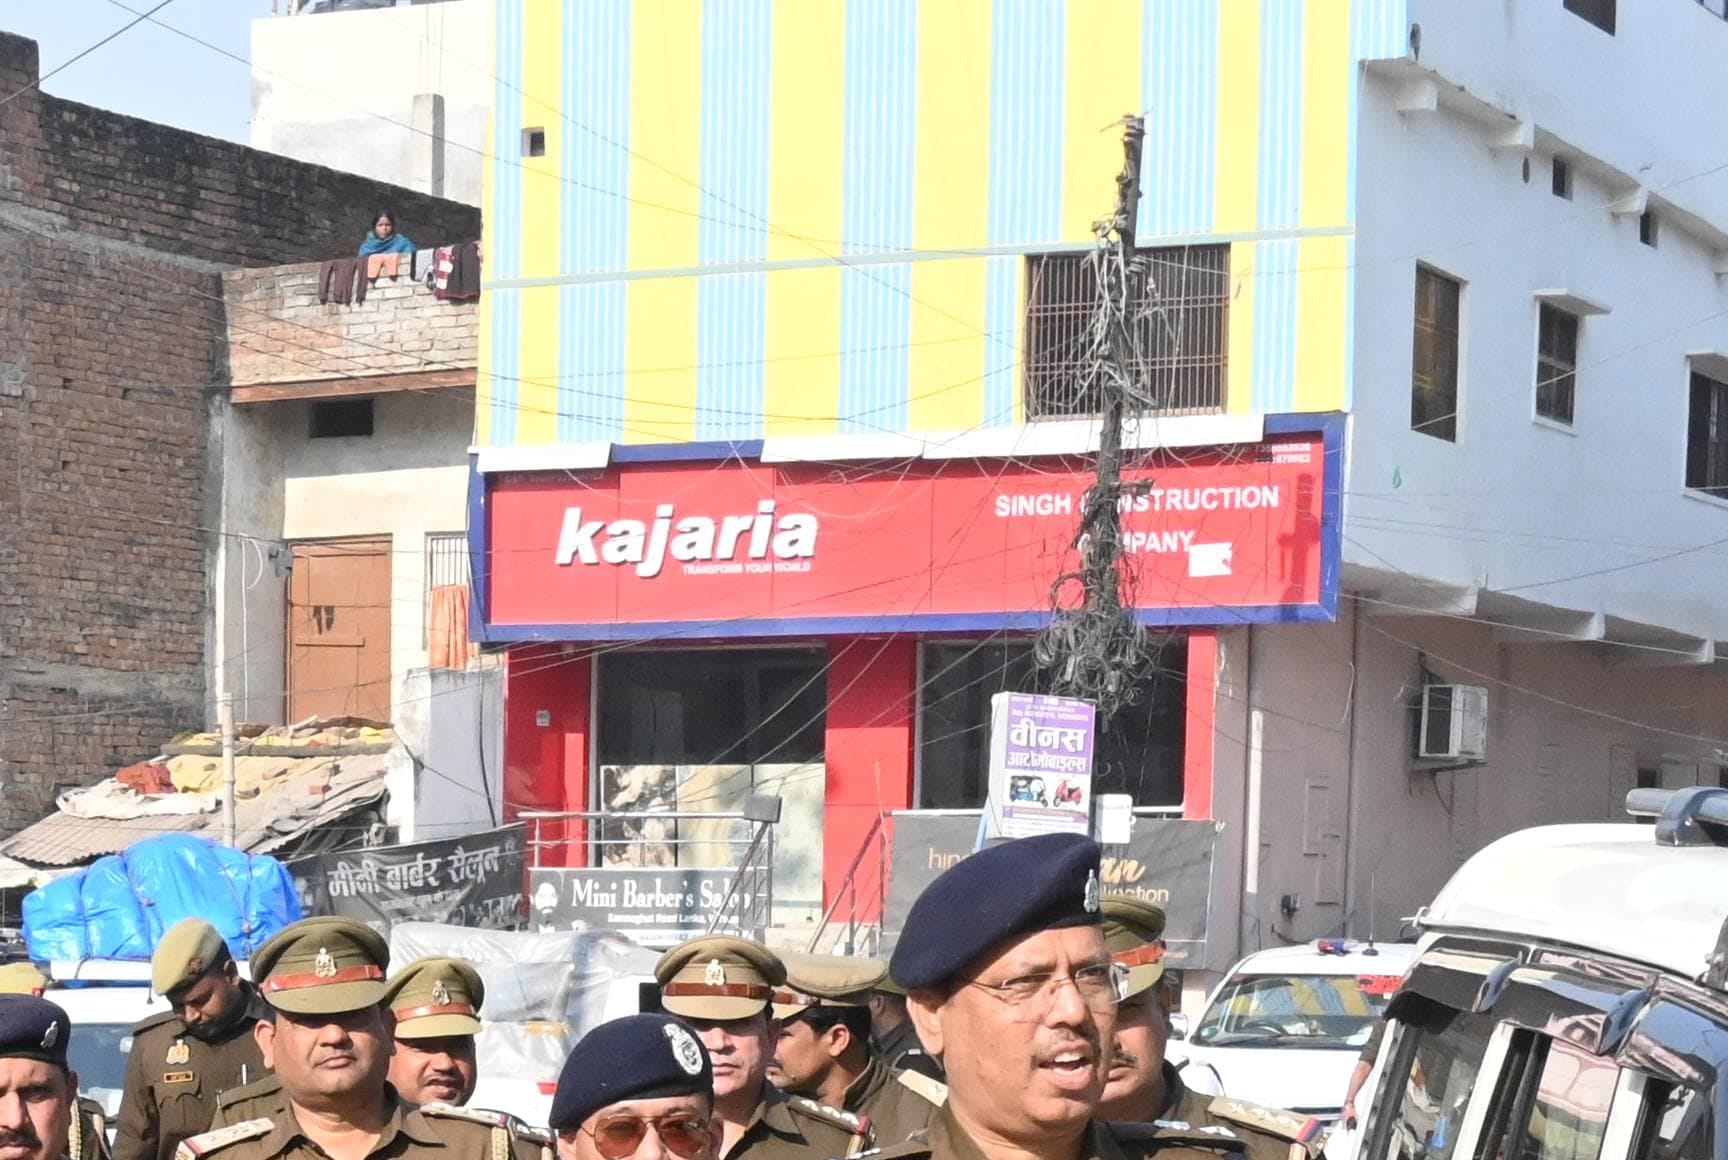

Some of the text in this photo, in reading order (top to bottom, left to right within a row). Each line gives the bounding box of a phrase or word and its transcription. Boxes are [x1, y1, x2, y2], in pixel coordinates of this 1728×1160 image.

[994, 494, 1071, 517] SINGH
[555, 499, 818, 578] kajaria
[745, 562, 773, 574] YOUR
[774, 561, 811, 573] WORLD
[1009, 717, 1087, 753] वीनस
[384, 852, 442, 891] बार्बर
[447, 845, 501, 884] सैलून
[572, 878, 617, 908] Mini
[623, 877, 695, 908] Barber's
[656, 913, 678, 924] Road
